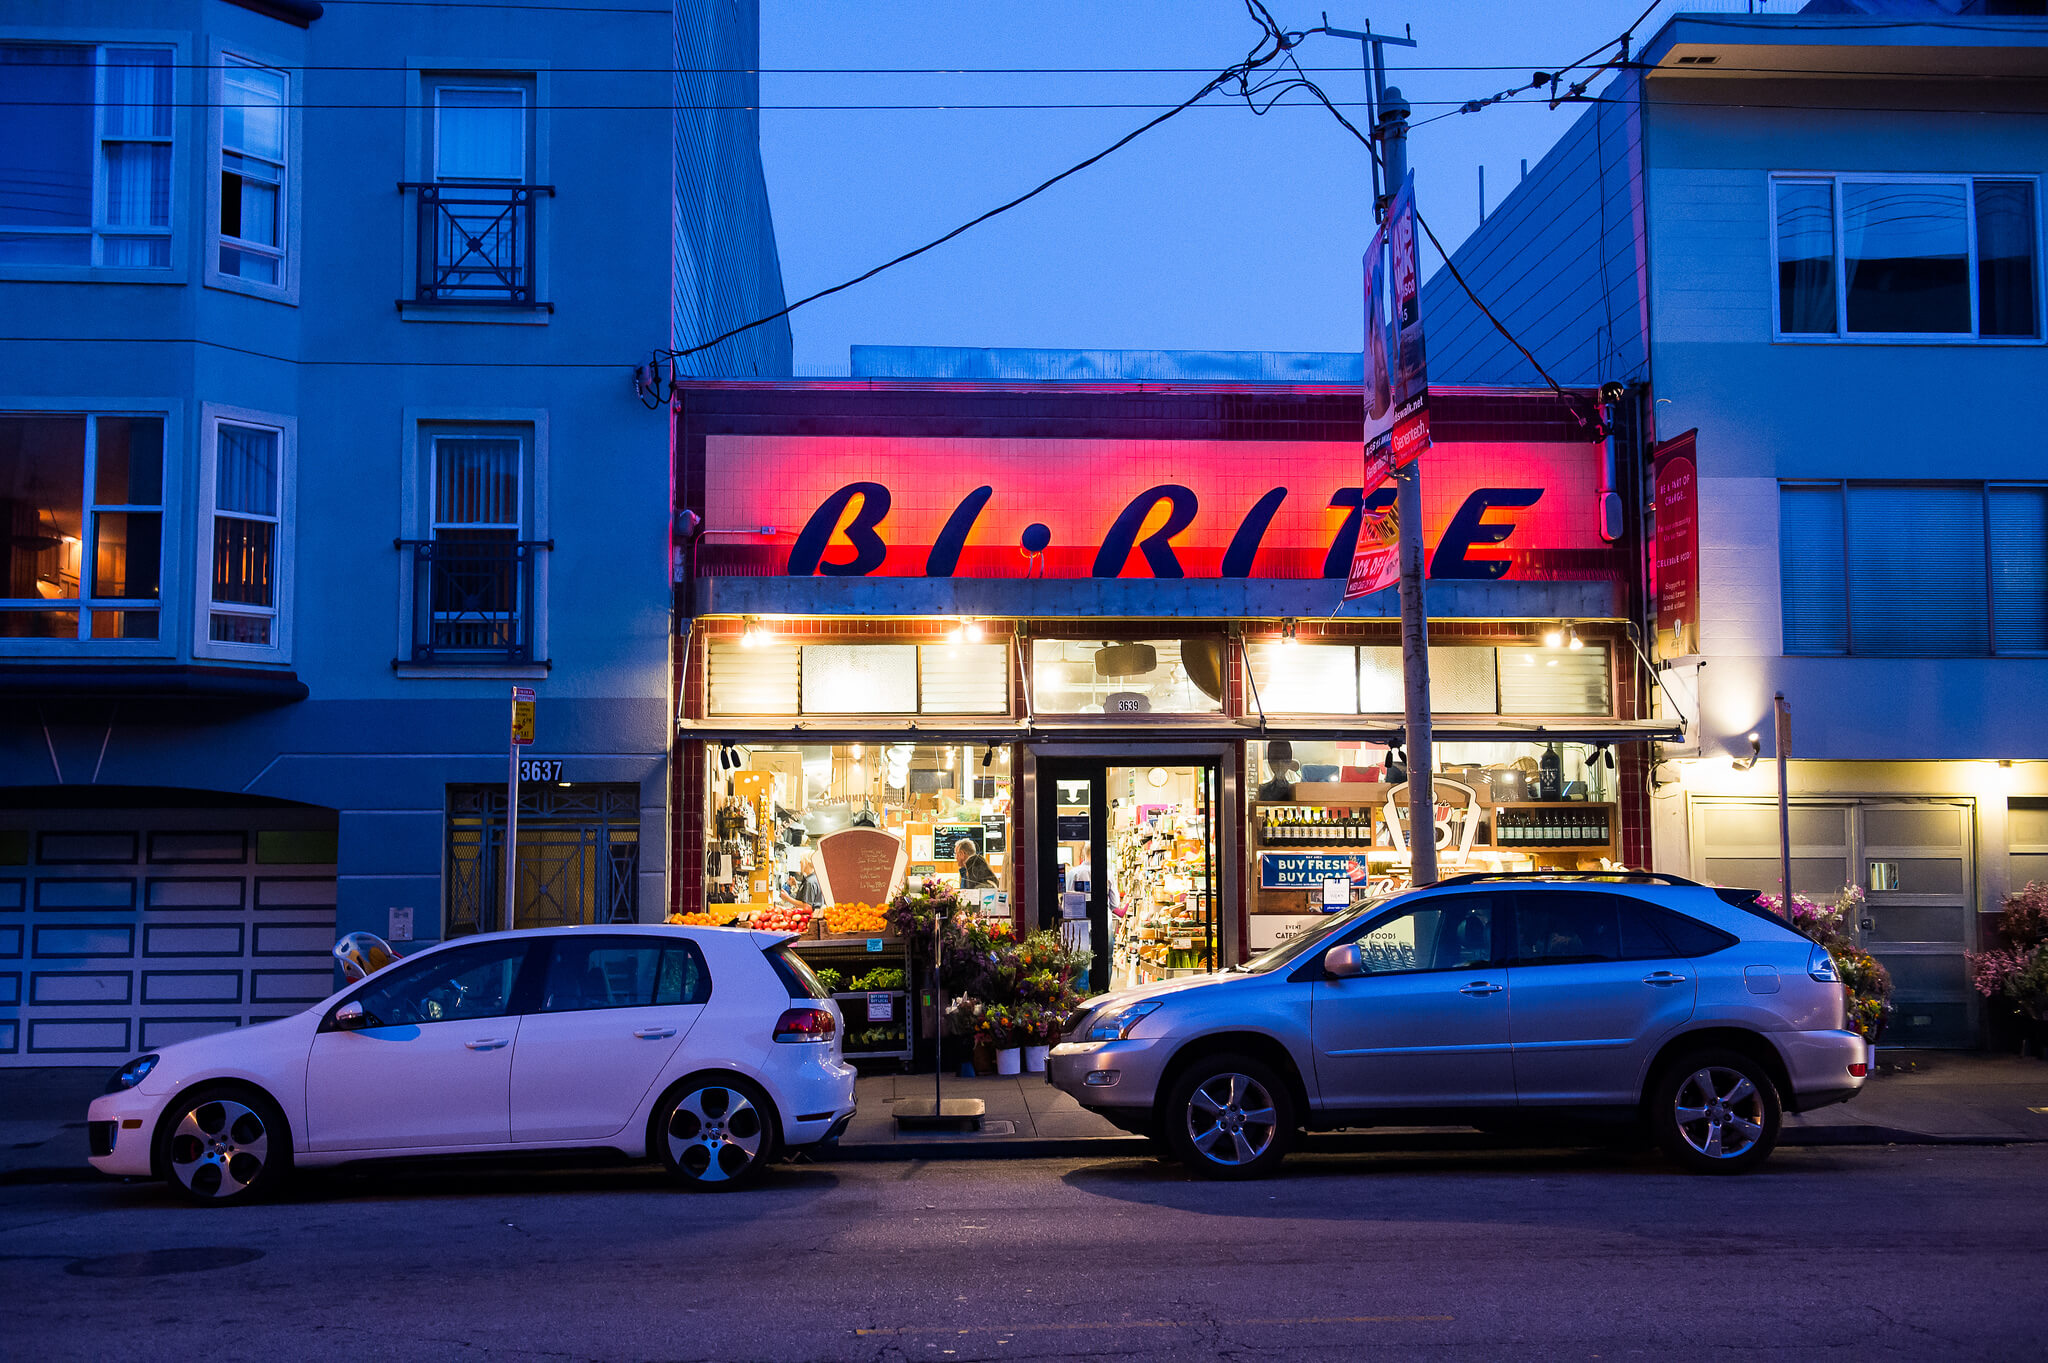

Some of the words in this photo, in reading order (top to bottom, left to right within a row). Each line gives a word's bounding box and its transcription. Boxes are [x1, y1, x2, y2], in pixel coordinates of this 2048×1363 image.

[1393, 420, 1426, 452] Genentech
[1682, 474, 1690, 487] OF
[1352, 558, 1371, 579] 10%
[1119, 700, 1139, 711] 3639
[521, 761, 562, 781] 3637
[1278, 859, 1305, 870] BUY
[1308, 859, 1349, 870] FRESH
[1278, 872, 1305, 883] BUY
[1370, 932, 1396, 940] FOODS
